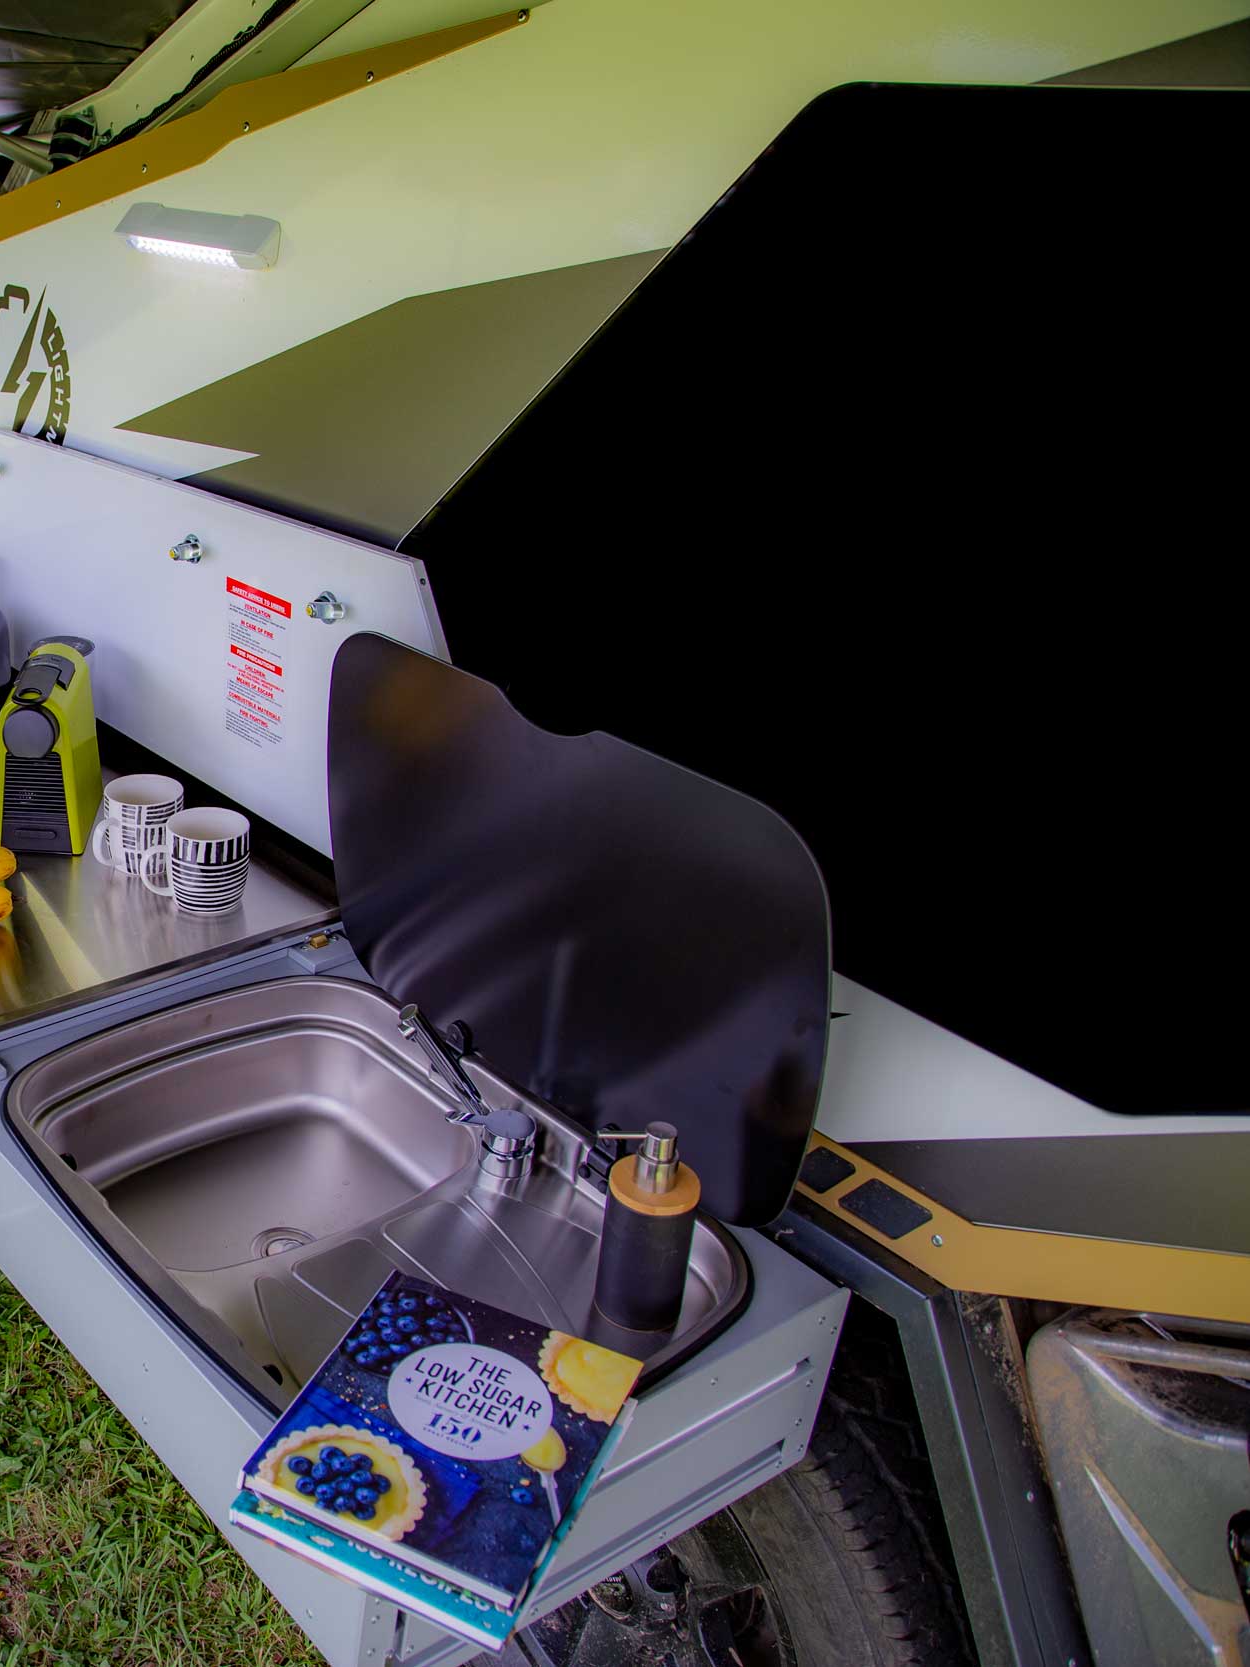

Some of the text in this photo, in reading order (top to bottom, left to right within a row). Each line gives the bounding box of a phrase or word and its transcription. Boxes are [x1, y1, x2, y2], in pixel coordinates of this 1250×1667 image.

[415, 1357, 465, 1386] LOW
[468, 1379, 543, 1419] SUGAR
[467, 1356, 512, 1386] THE
[418, 1378, 518, 1429] KITCHEN
[425, 1412, 482, 1443] 150
